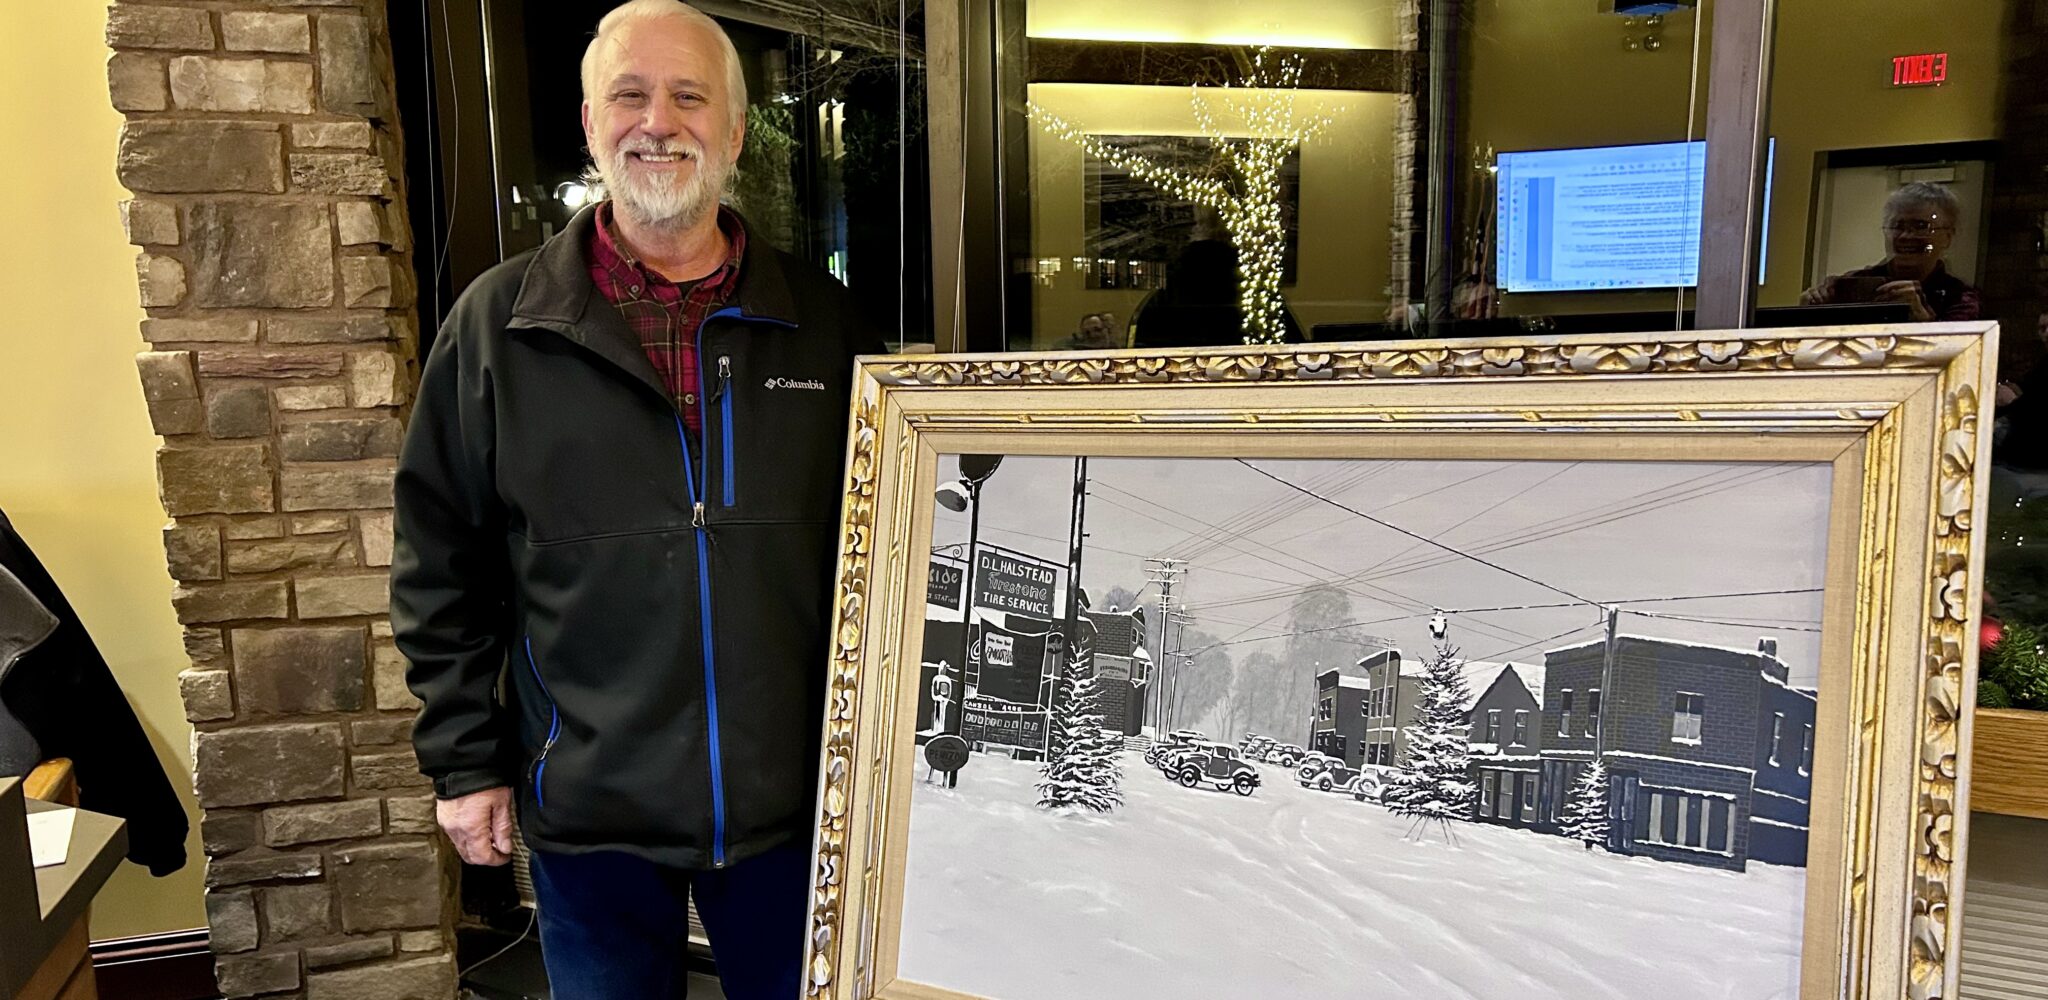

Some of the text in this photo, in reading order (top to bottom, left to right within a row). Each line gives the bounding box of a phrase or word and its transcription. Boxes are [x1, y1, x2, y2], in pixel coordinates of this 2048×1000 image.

[776, 377, 825, 390] Columbia
[1000, 559, 1054, 584] HALSTEAD
[987, 571, 1047, 600] Firestone
[983, 591, 1049, 615] TIRE SERVICE
